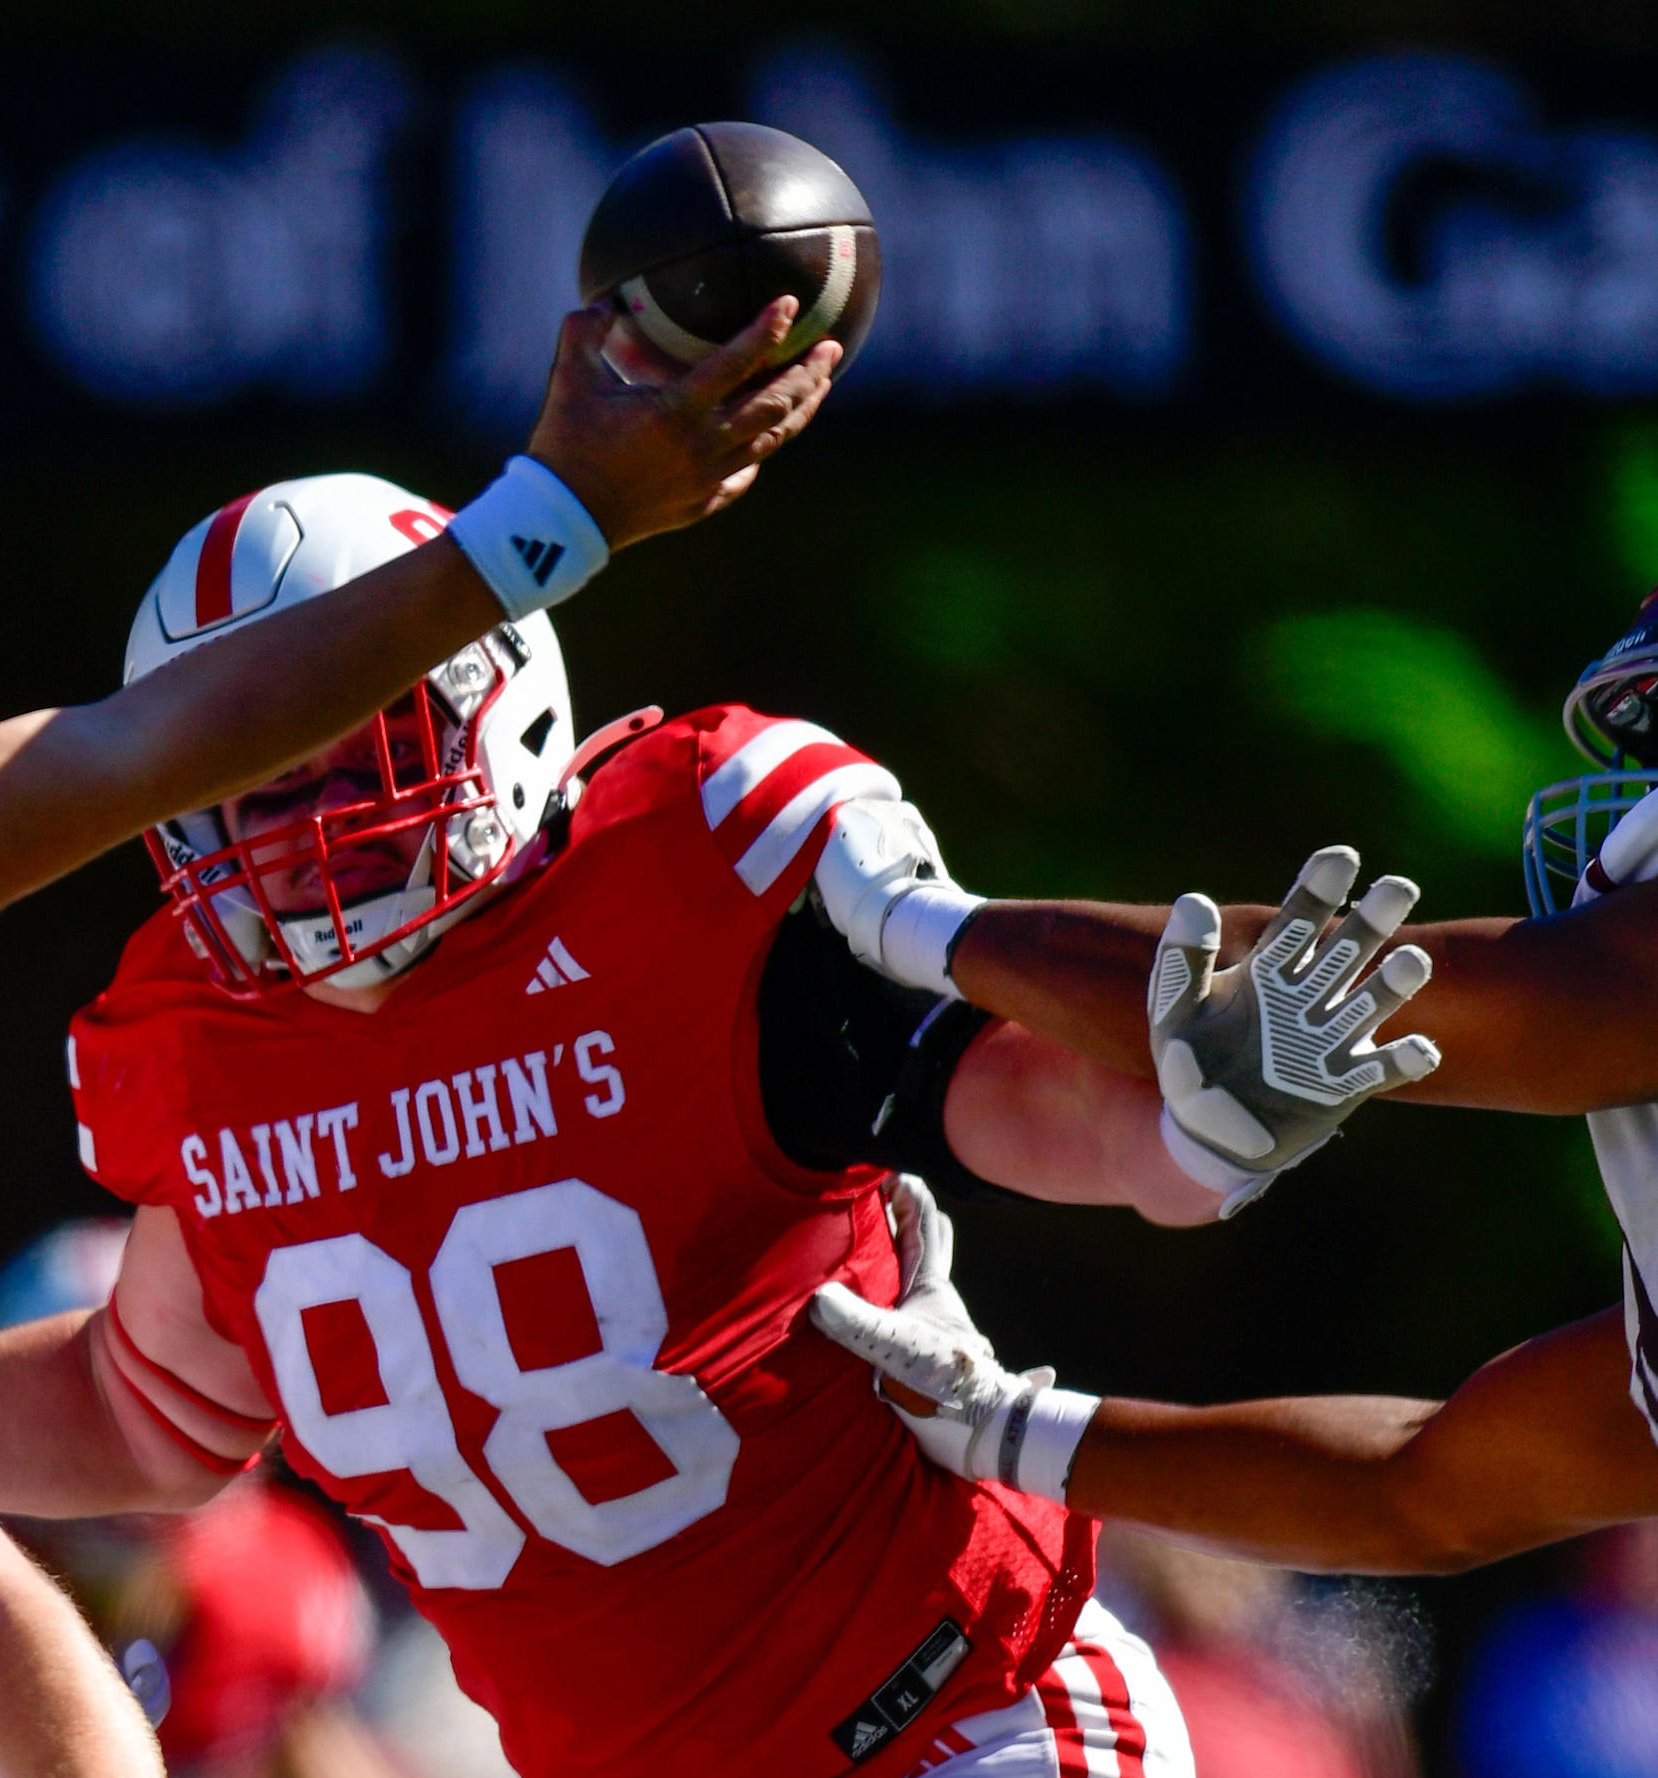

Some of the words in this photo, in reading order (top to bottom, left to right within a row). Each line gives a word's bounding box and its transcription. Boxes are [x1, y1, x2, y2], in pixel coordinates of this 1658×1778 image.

[181, 1102, 359, 1219] SAINT
[378, 1029, 626, 1179] JOHN'S
[254, 1178, 741, 1590] 98
